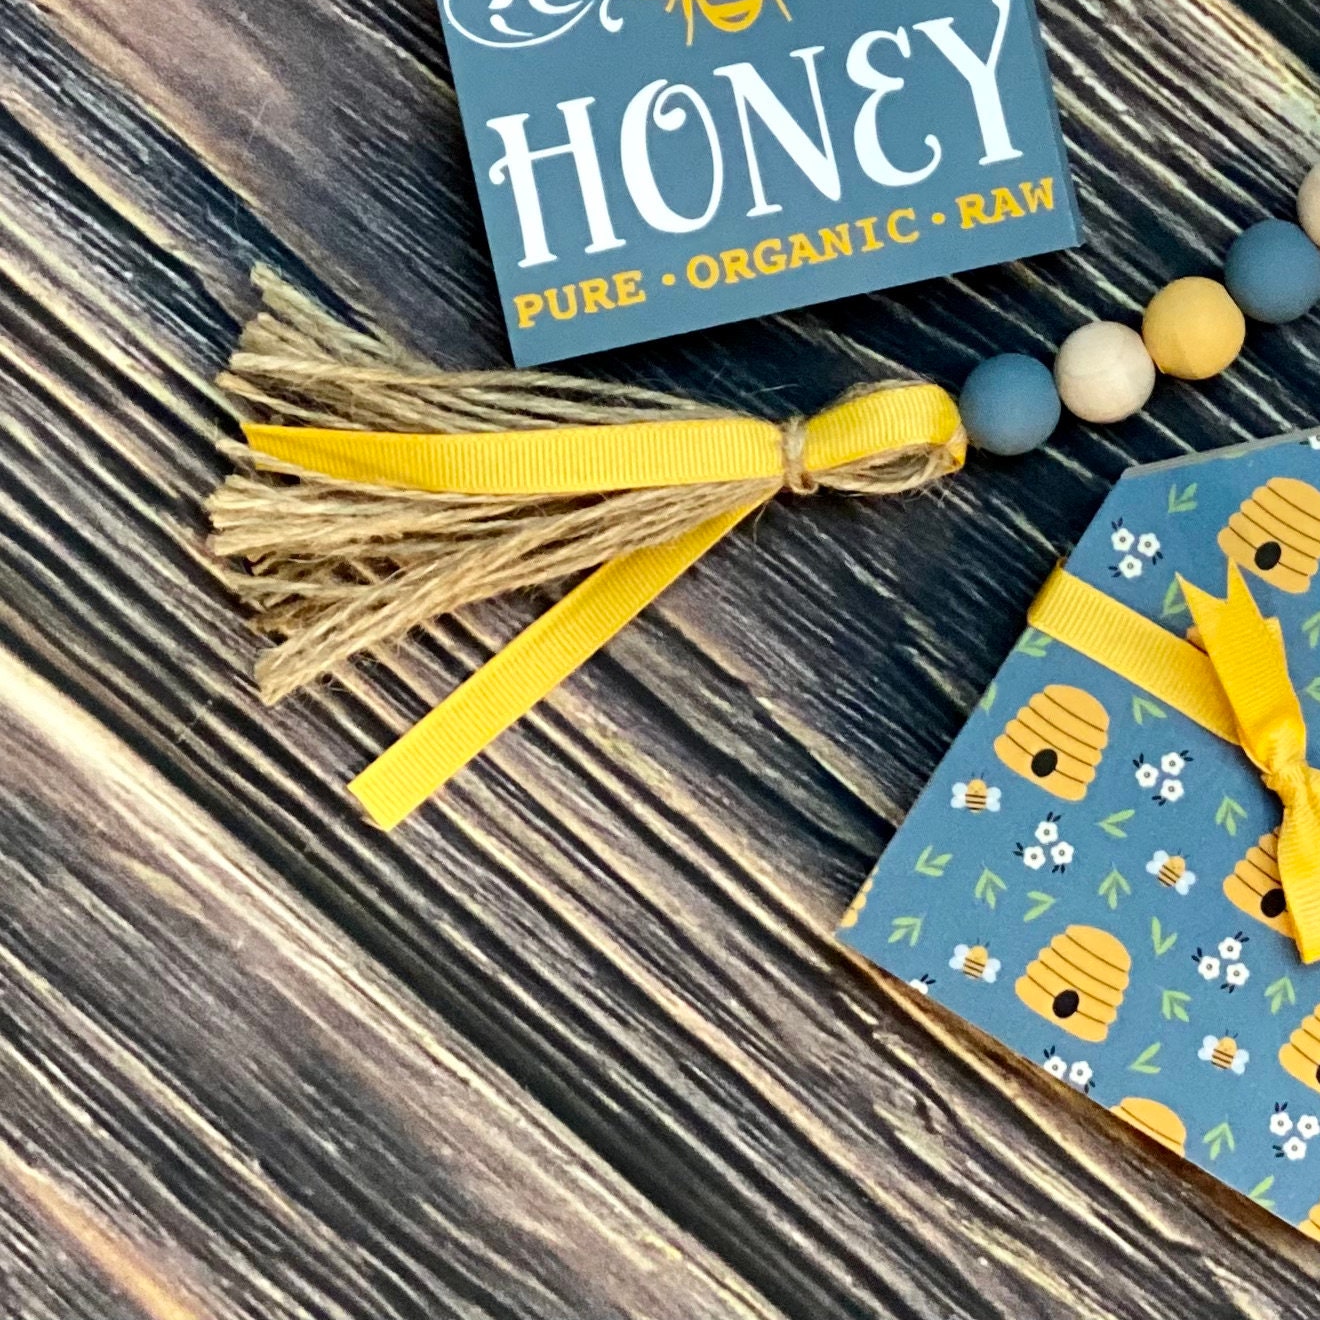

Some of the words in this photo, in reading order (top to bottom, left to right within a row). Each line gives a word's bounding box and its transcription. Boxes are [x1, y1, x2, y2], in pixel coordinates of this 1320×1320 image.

[513, 271, 646, 329] PURE
[686, 208, 920, 290] ORGANIC
[955, 177, 1055, 230] RAW
